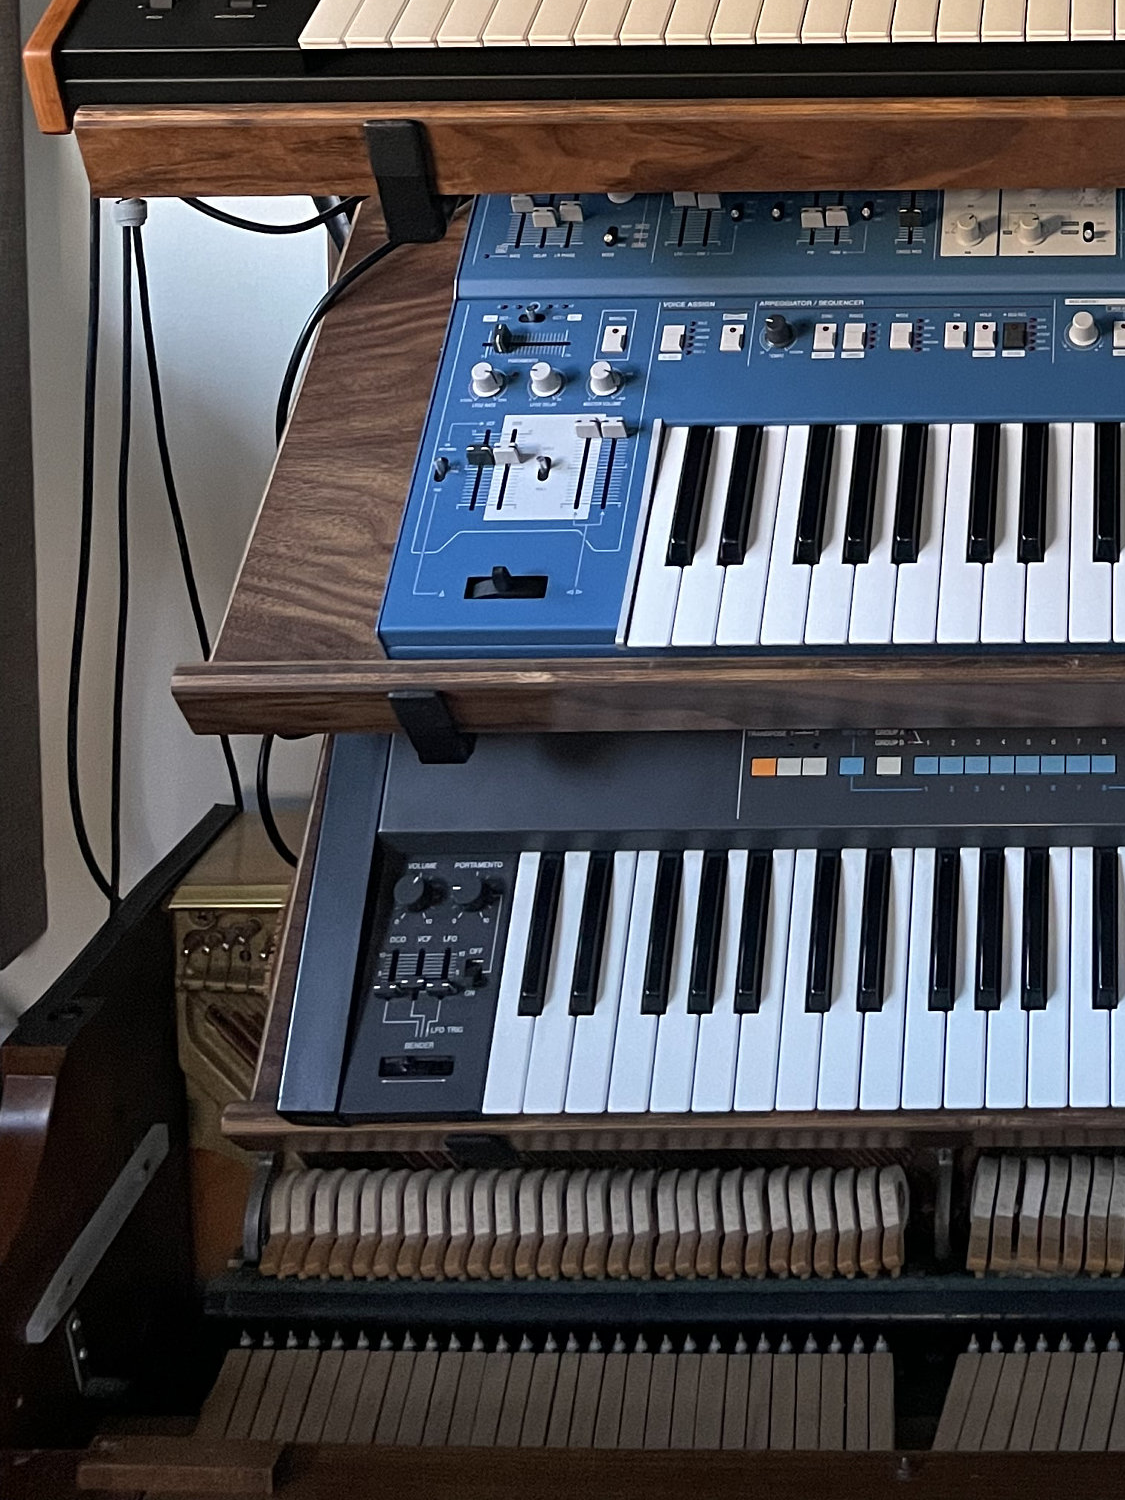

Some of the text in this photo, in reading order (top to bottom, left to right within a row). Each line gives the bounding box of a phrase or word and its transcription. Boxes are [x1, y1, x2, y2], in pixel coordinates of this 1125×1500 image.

[663, 301, 716, 309] VOICE ASSIGN
[758, 300, 814, 308] ARPEGGIATOR
[818, 300, 865, 308] SEQUENCER
[874, 729, 899, 737] GROUP
[874, 739, 899, 747] GROUP
[407, 861, 438, 870] VOLUME
[454, 860, 504, 869] PORTAMENTO
[389, 935, 408, 944] DCO
[417, 935, 433, 943] VCF
[442, 935, 458, 943] LFO
[468, 947, 484, 956] OFF
[463, 989, 477, 997] ON
[430, 1025, 465, 1035] LFO TRIG
[403, 1041, 435, 1050] BENDER
